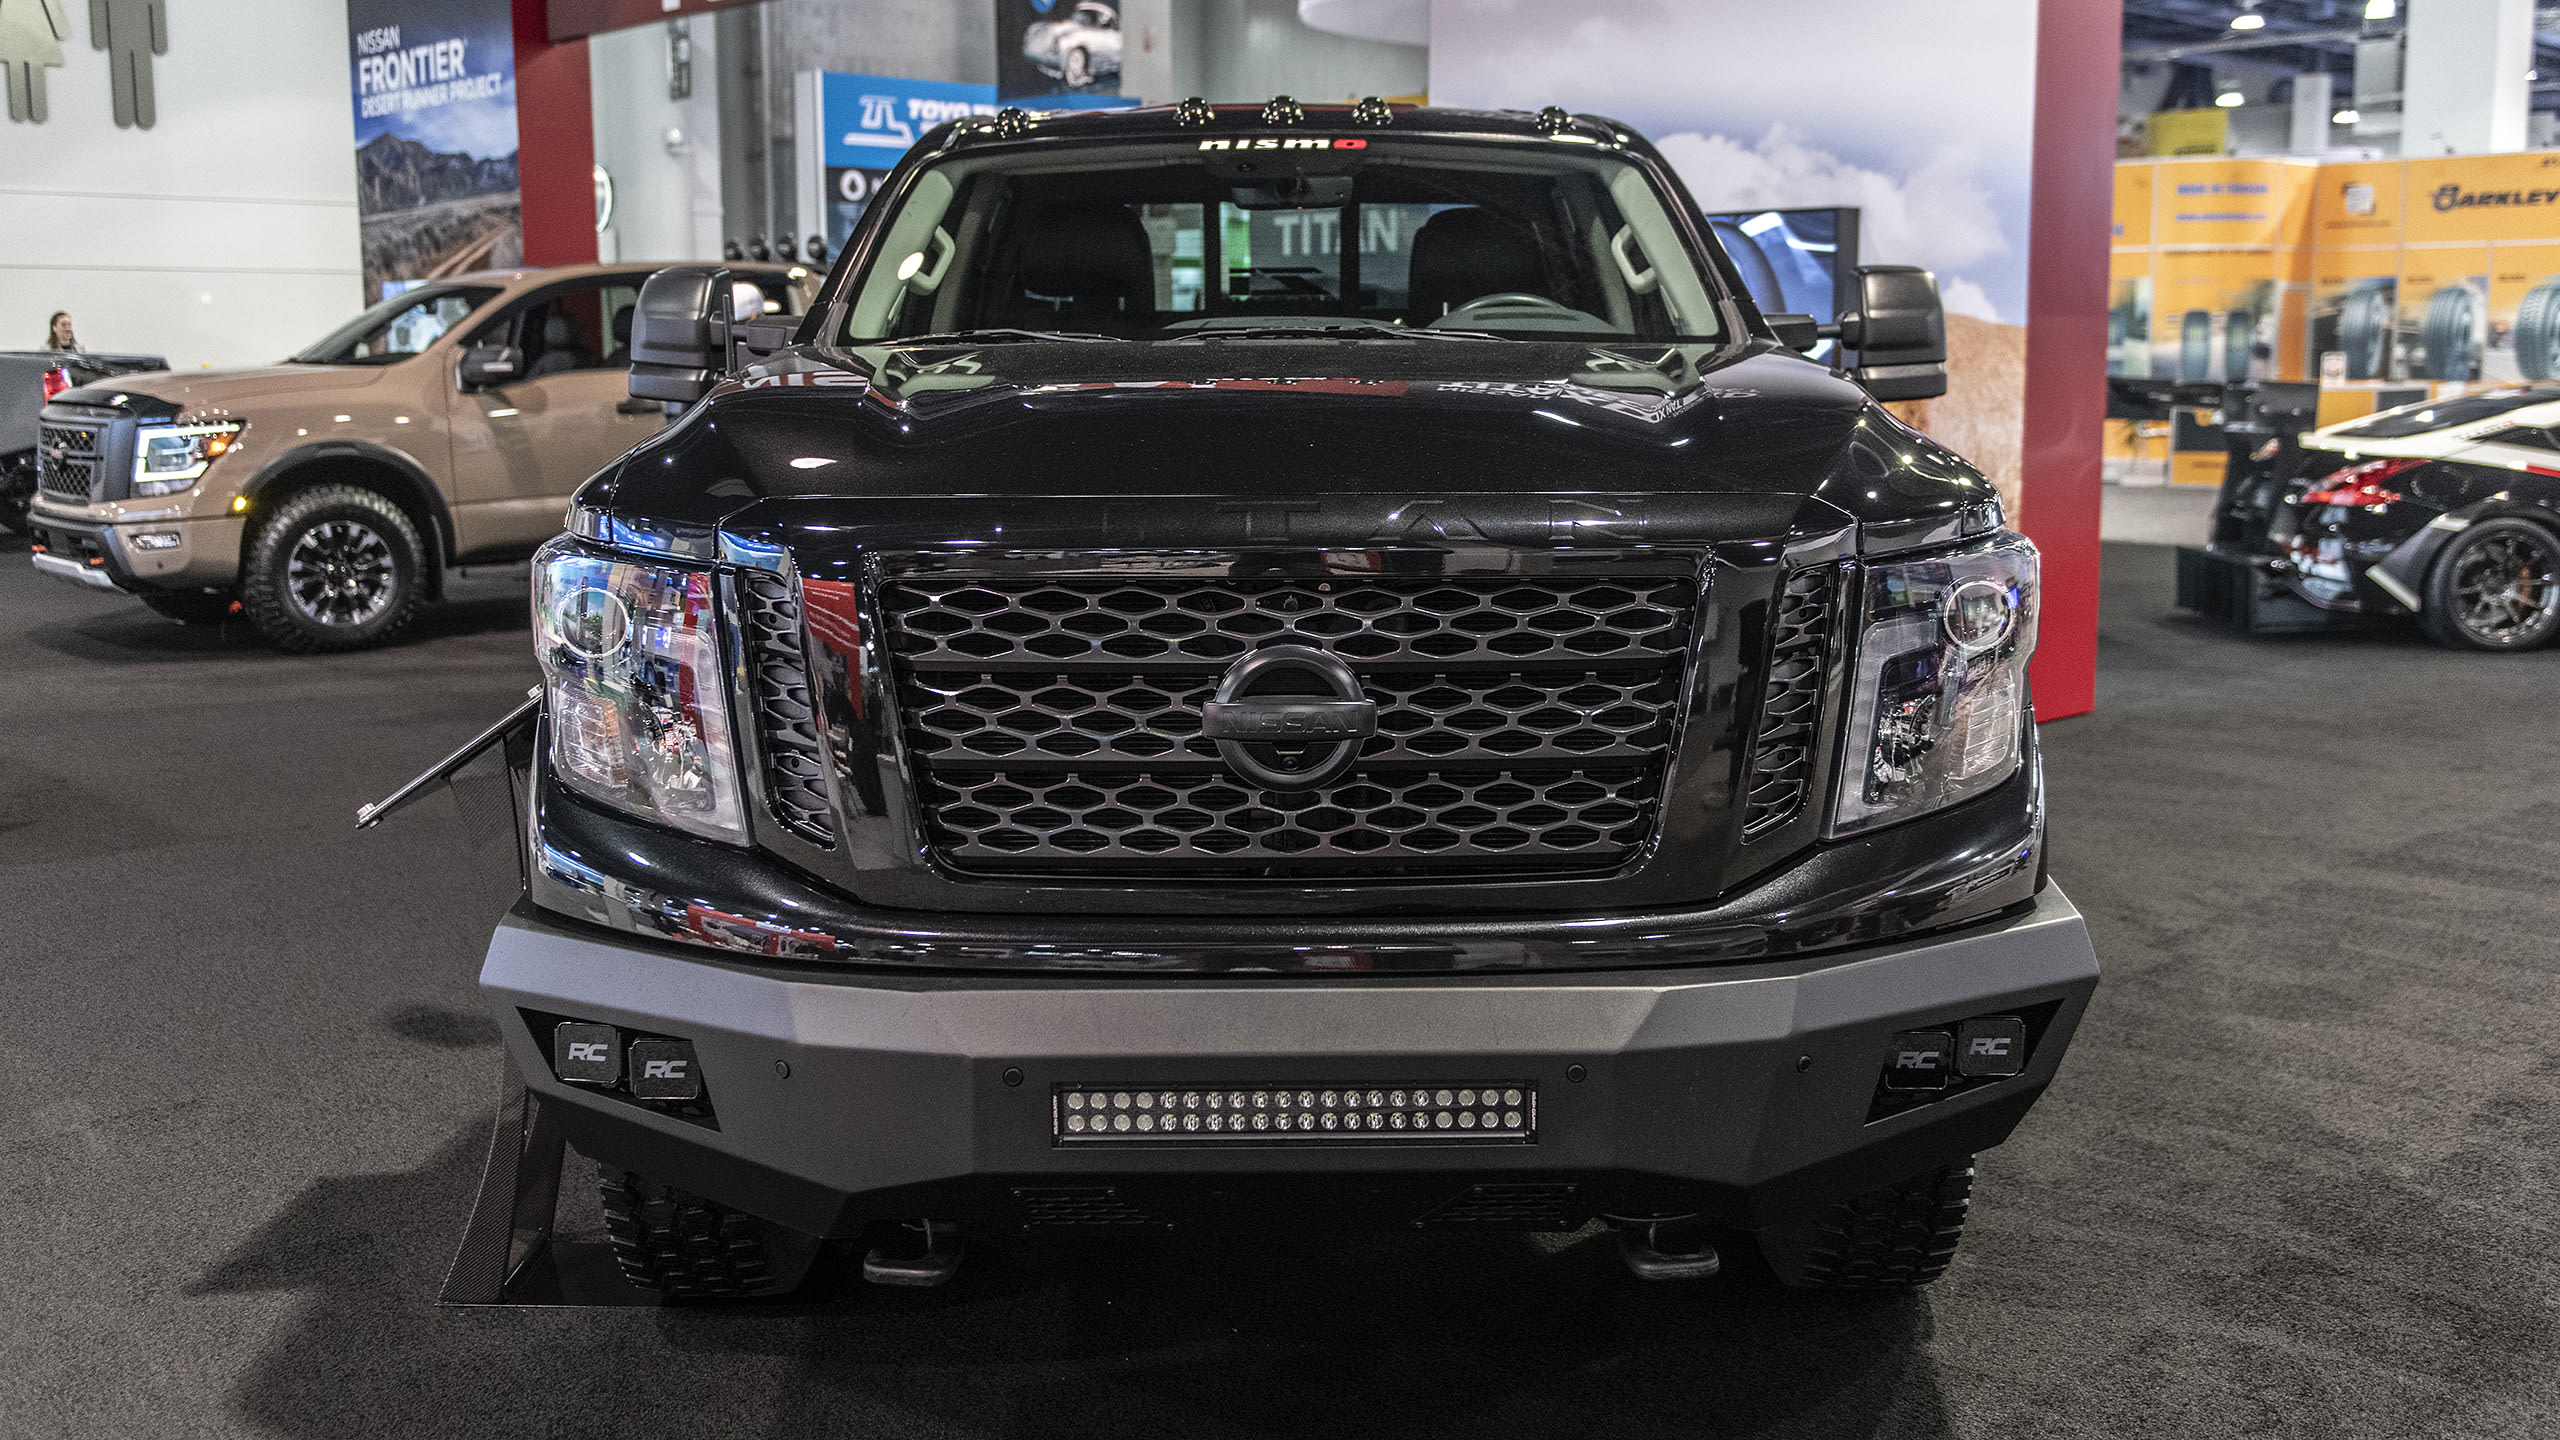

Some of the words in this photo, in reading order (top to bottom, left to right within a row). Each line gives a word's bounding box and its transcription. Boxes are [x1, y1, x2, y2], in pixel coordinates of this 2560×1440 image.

[357, 24, 400, 55] NISSAN
[359, 38, 466, 94] FRONTIER
[450, 71, 502, 100] PROJECT
[1222, 711, 1360, 733] NISSAN
[567, 1042, 608, 1062] RC
[1968, 1037, 2011, 1056] RC
[643, 1060, 687, 1079] RC
[1895, 1051, 1939, 1069] RC
